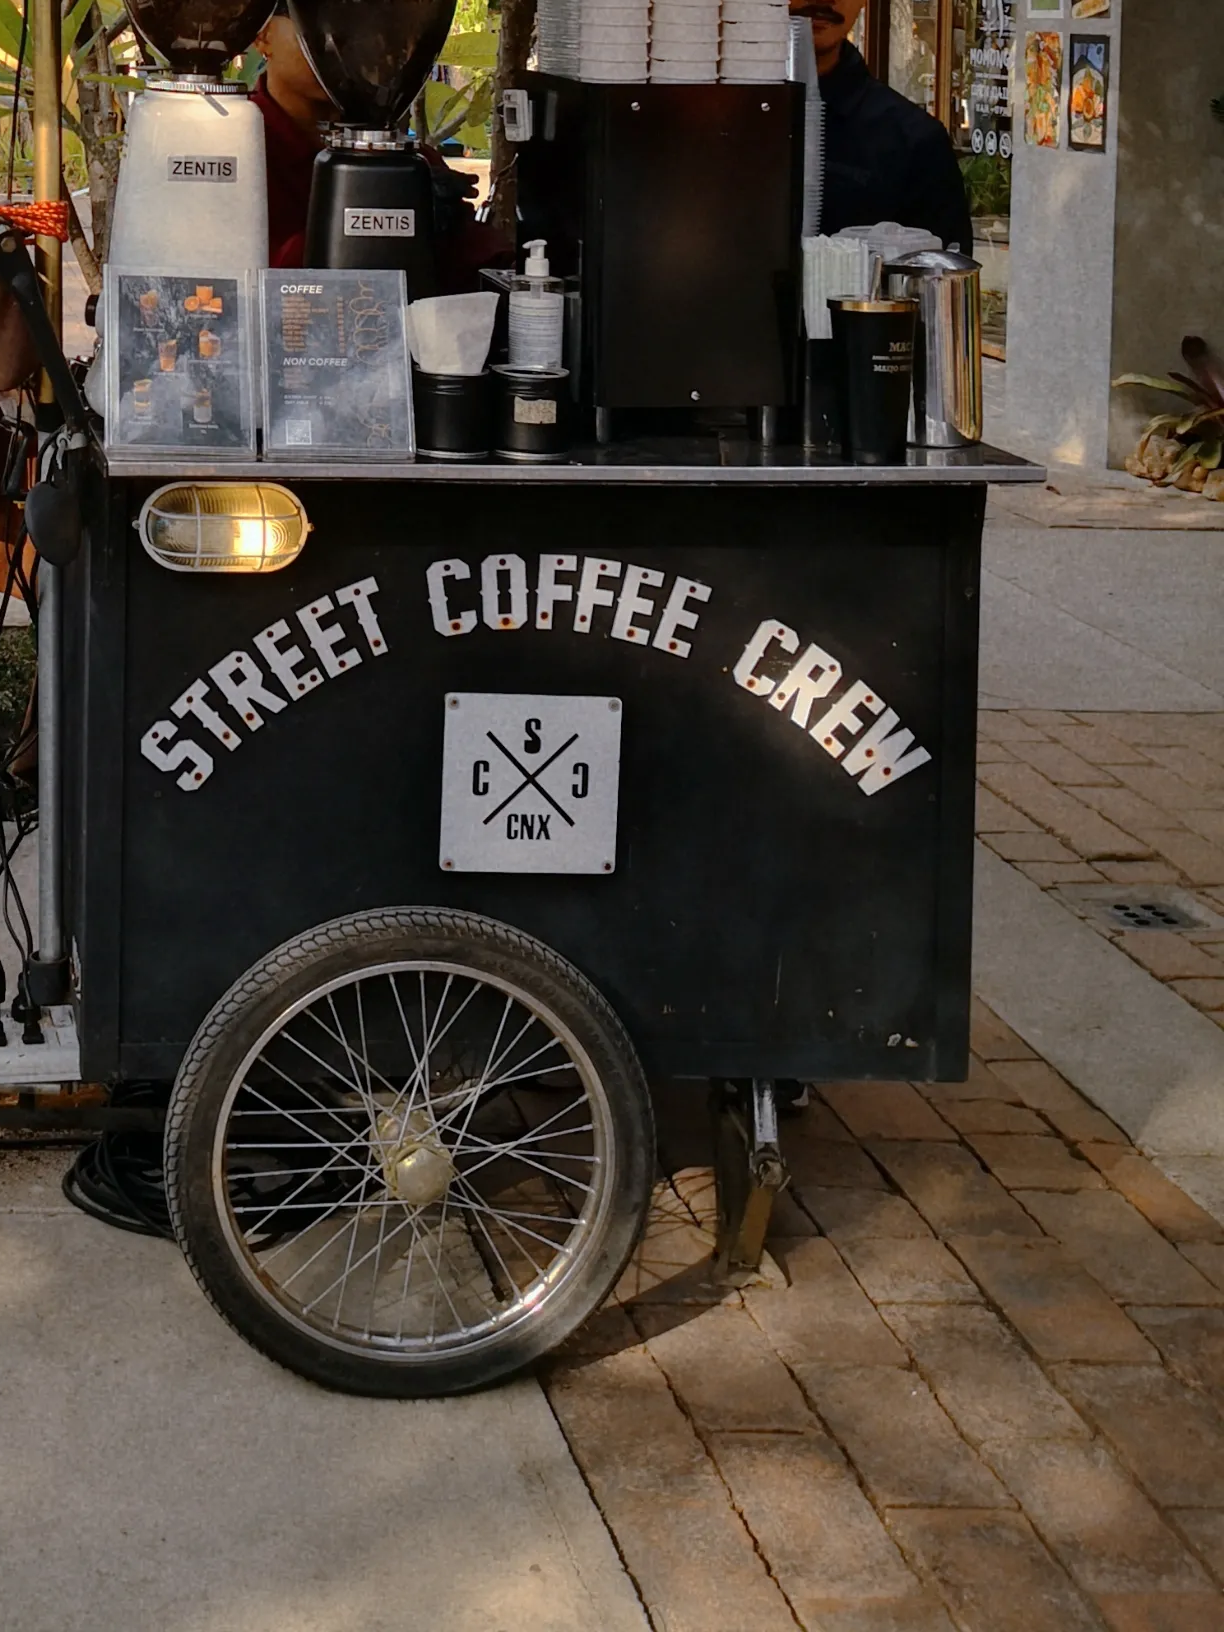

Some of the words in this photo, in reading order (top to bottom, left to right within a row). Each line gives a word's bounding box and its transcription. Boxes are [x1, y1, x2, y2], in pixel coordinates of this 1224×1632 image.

[172, 160, 233, 177] ZENTIS
[350, 215, 410, 231] ZENTIS
[280, 284, 323, 294] COFFEE
[283, 357, 306, 366] NON
[308, 357, 348, 367] COFFEE
[141, 576, 391, 791] STREET
[426, 554, 712, 658] COFFEE
[732, 619, 932, 797] CREW
[523, 717, 542, 755] S
[472, 759, 490, 797] C
[506, 813, 551, 841] CNX
